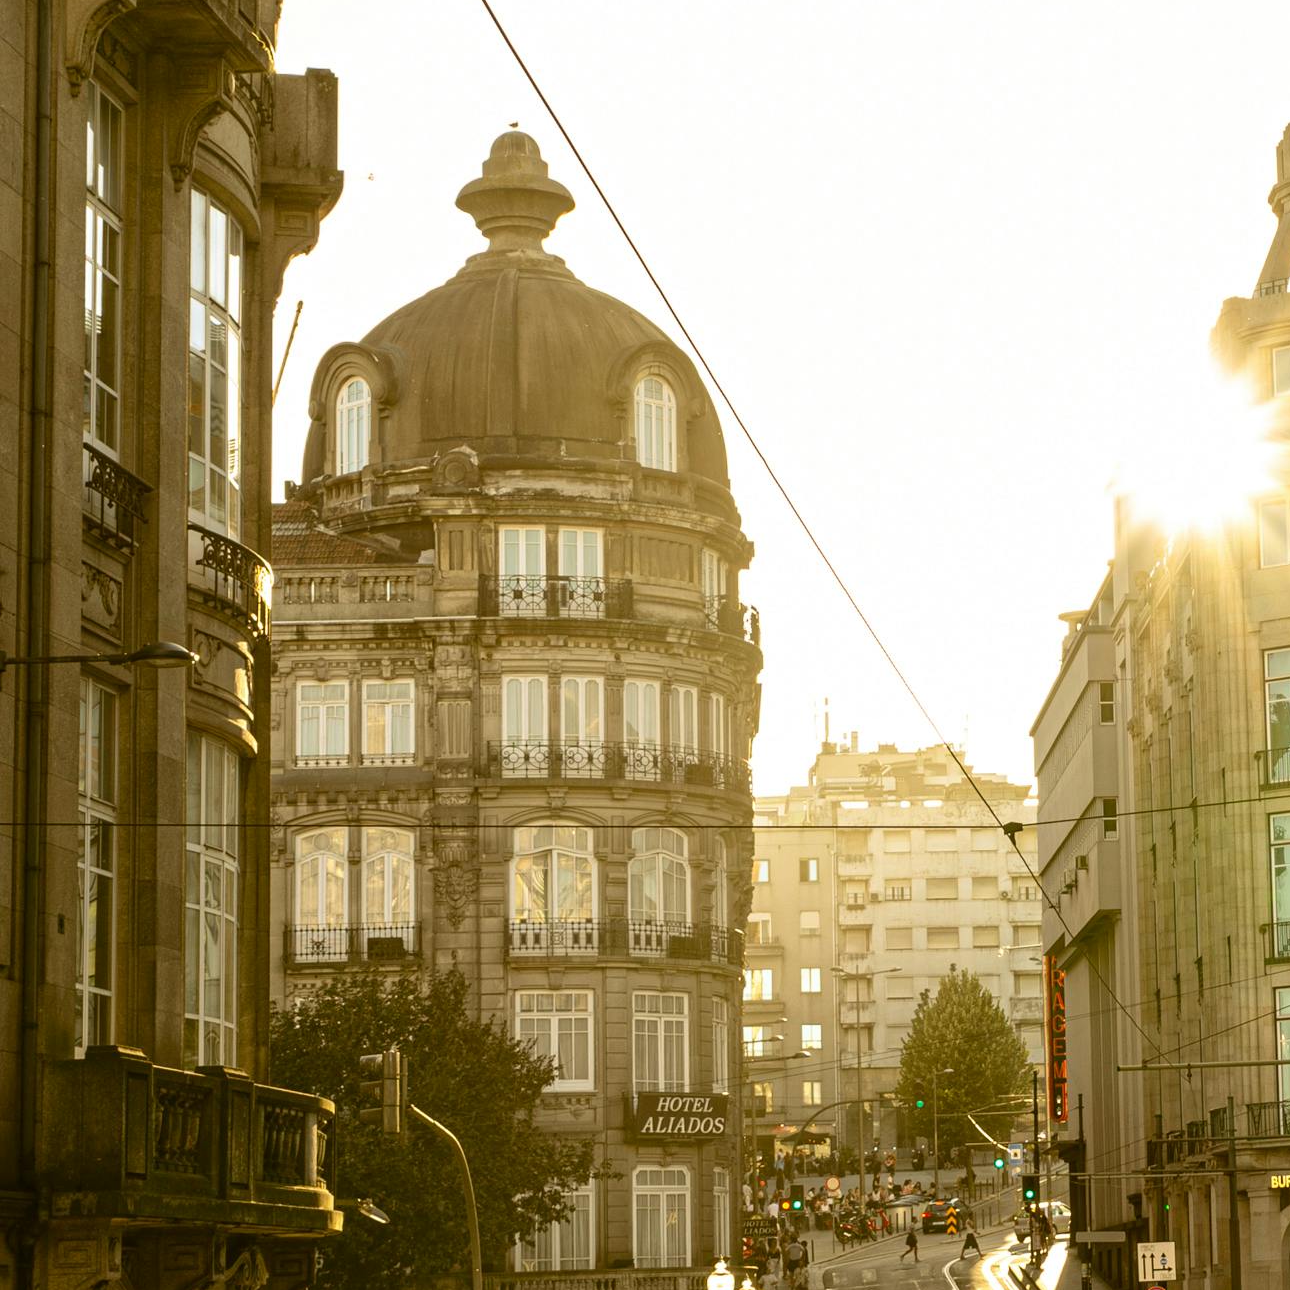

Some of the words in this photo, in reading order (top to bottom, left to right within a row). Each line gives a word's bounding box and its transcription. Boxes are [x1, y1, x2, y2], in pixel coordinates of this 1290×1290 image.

[1052, 957, 1067, 1080] RAGEM
[656, 1096, 714, 1113] HOTEL
[640, 1116, 725, 1134] ALIADOS
